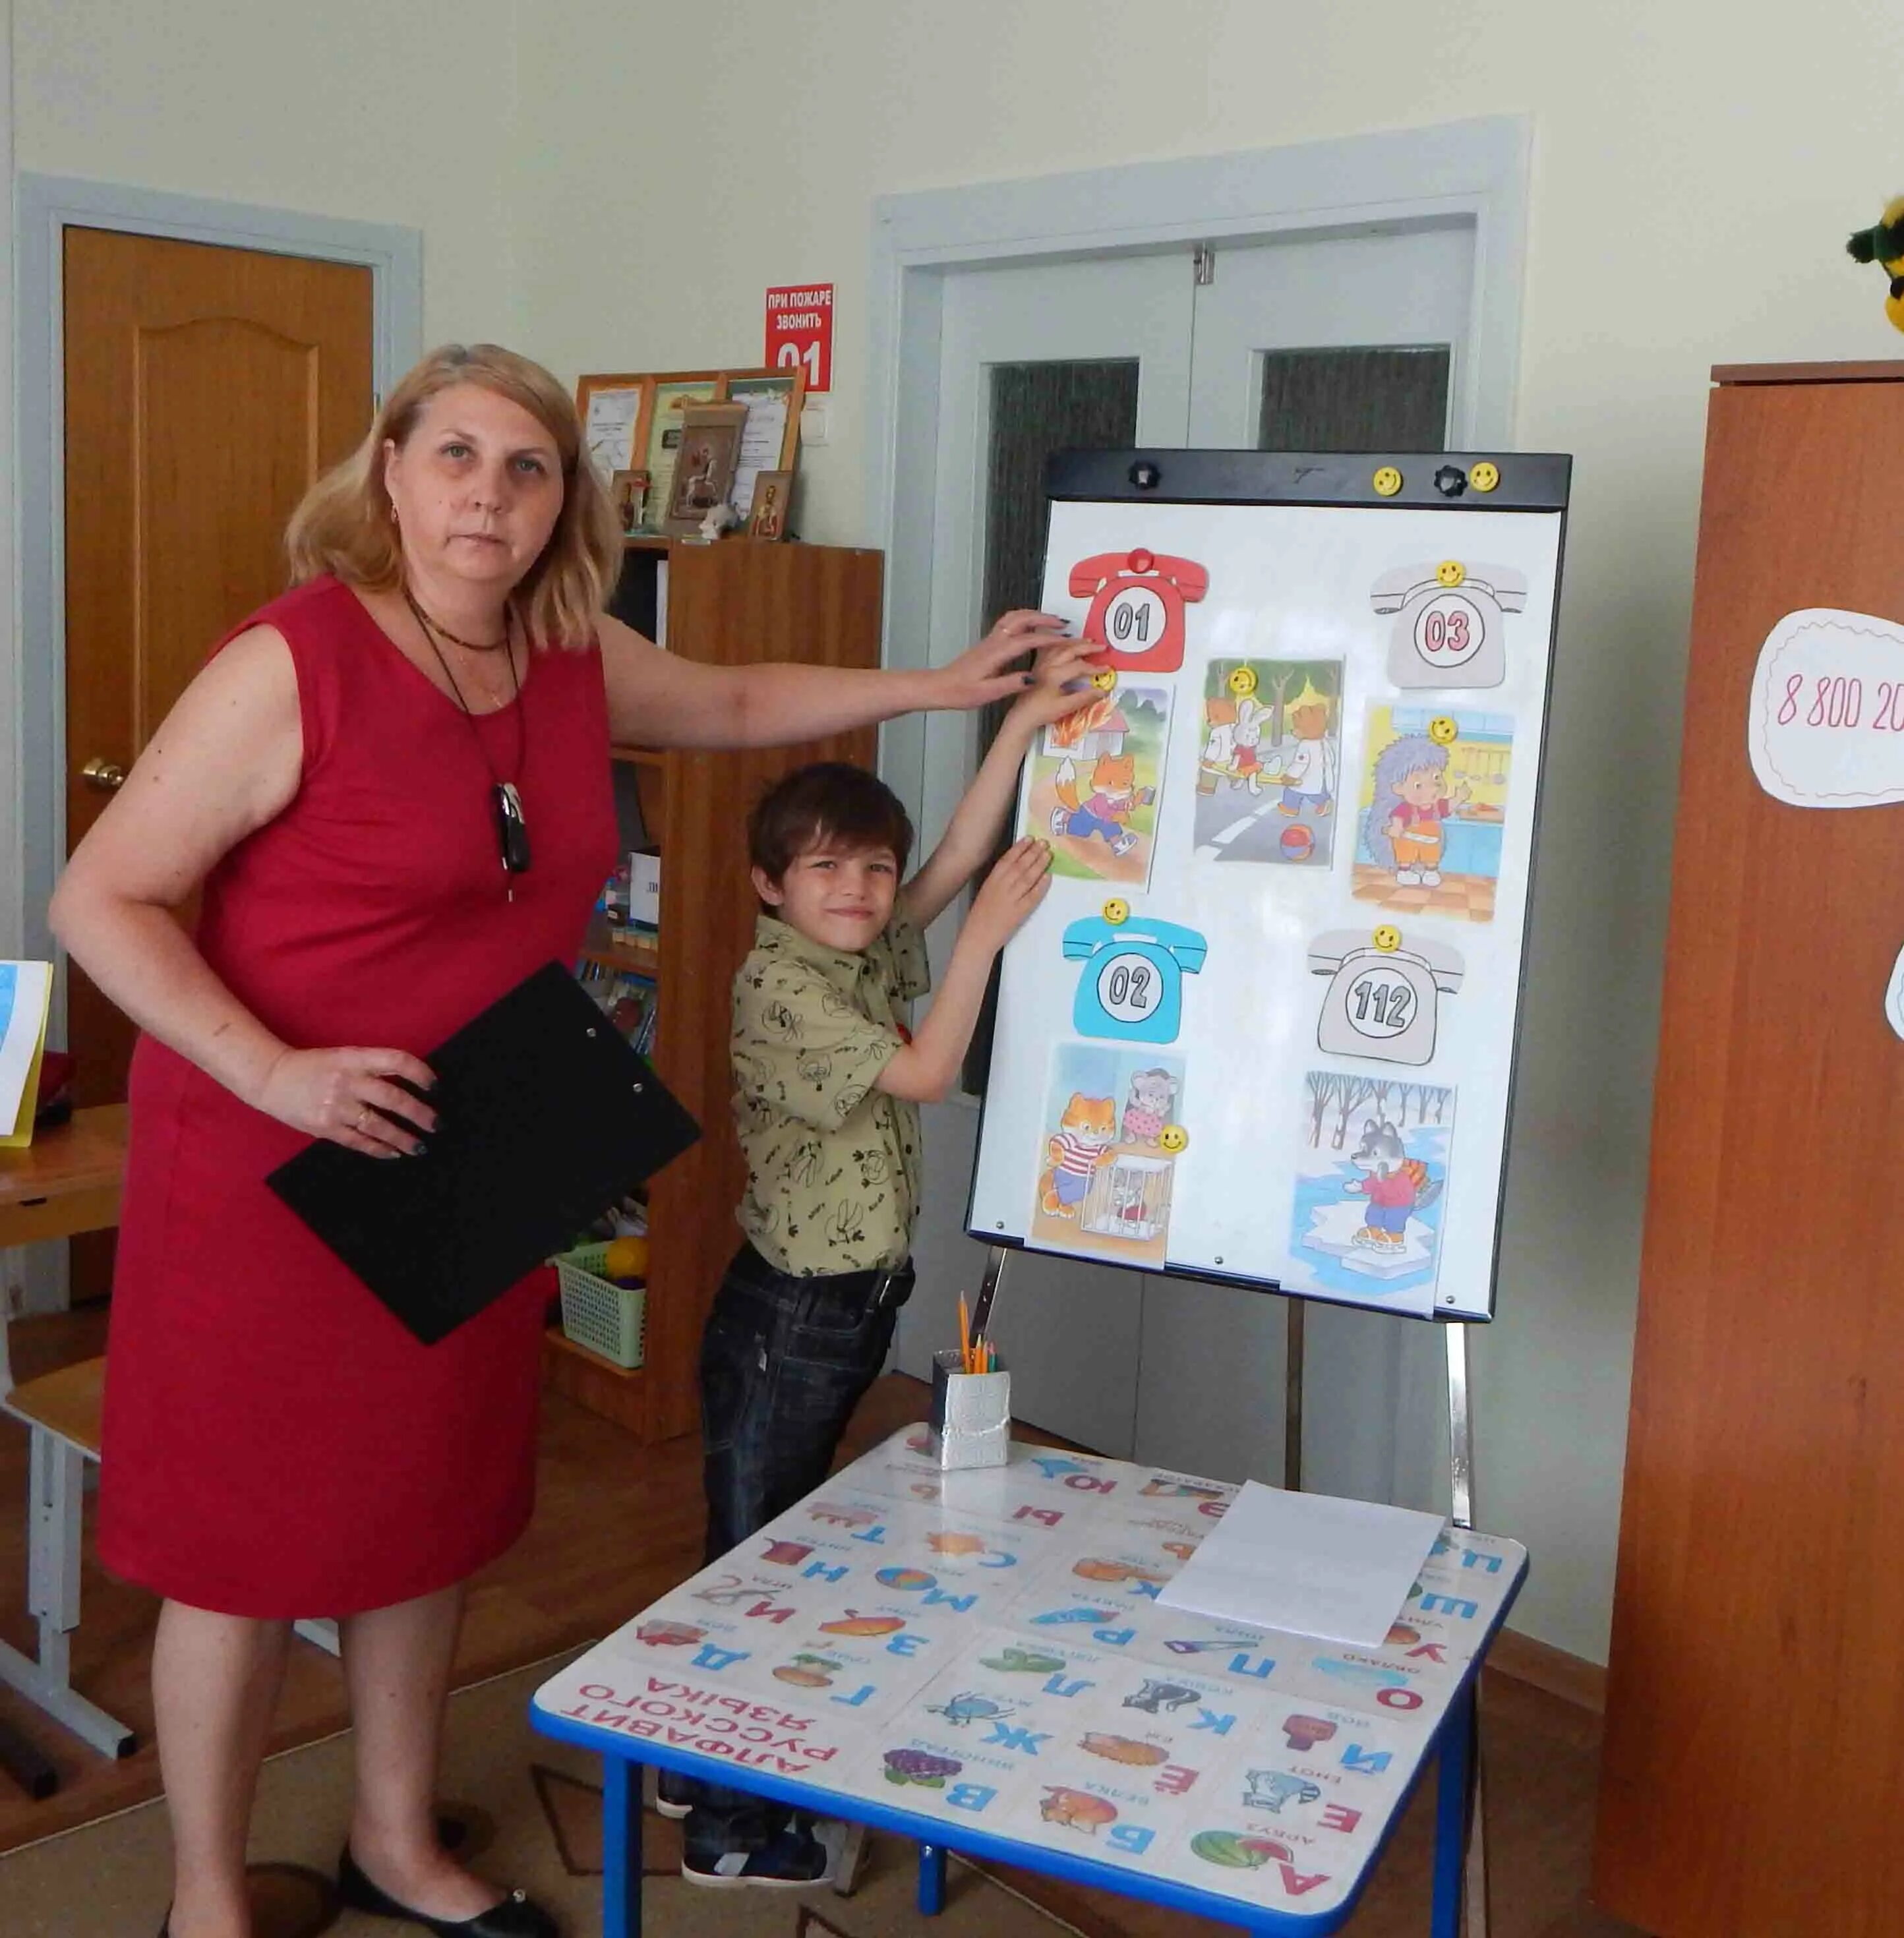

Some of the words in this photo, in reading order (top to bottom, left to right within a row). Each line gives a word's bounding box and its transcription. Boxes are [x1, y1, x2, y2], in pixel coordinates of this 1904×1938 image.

[767, 293, 788, 309] ПРИ
[790, 290, 832, 308] ПОЖАРЕ
[776, 312, 822, 330] ЗВОНИТЬ
[1113, 602, 1152, 643] 01
[1423, 610, 1472, 653] 03
[1777, 674, 1803, 725] 8
[1806, 676, 1862, 728] 800
[1108, 966, 1148, 1009] 02
[1355, 981, 1410, 1028] 112
[1063, 1475, 1118, 1495] Ю
[1011, 1505, 1065, 1527] Ы
[850, 1526, 886, 1545] Т
[799, 1561, 849, 1583] Н
[978, 1550, 1017, 1568] С
[1462, 1548, 1502, 1574] Ц
[744, 1600, 796, 1624] И
[920, 1588, 976, 1613] М
[1419, 1593, 1478, 1619] Ш
[885, 1634, 930, 1658] З
[1092, 1628, 1137, 1647] Р
[690, 1643, 752, 1672] Д
[1226, 1653, 1276, 1680] П
[1342, 1653, 1421, 1674] ОБЛАКО
[1403, 1643, 1447, 1665] У
[829, 1685, 876, 1707] Г
[1042, 1673, 1096, 1698] Л
[645, 1676, 816, 1732] ЯЗЫКА
[1376, 1688, 1423, 1710] О
[579, 1684, 839, 1762] РУССКОГО
[1185, 1708, 1237, 1736] К
[560, 1703, 810, 1775] АЛФАВИТ
[979, 1722, 1055, 1757] Ж
[1339, 1744, 1392, 1776] Й
[1085, 1781, 1150, 1806] БЕЛКА
[1153, 1765, 1199, 1796] Ё
[945, 1783, 998, 1812] В
[1316, 1804, 1363, 1833] Е
[1105, 1825, 1156, 1855] Б
[1246, 1823, 1315, 1846] АРБУЗ
[1279, 1864, 1330, 1896] А
